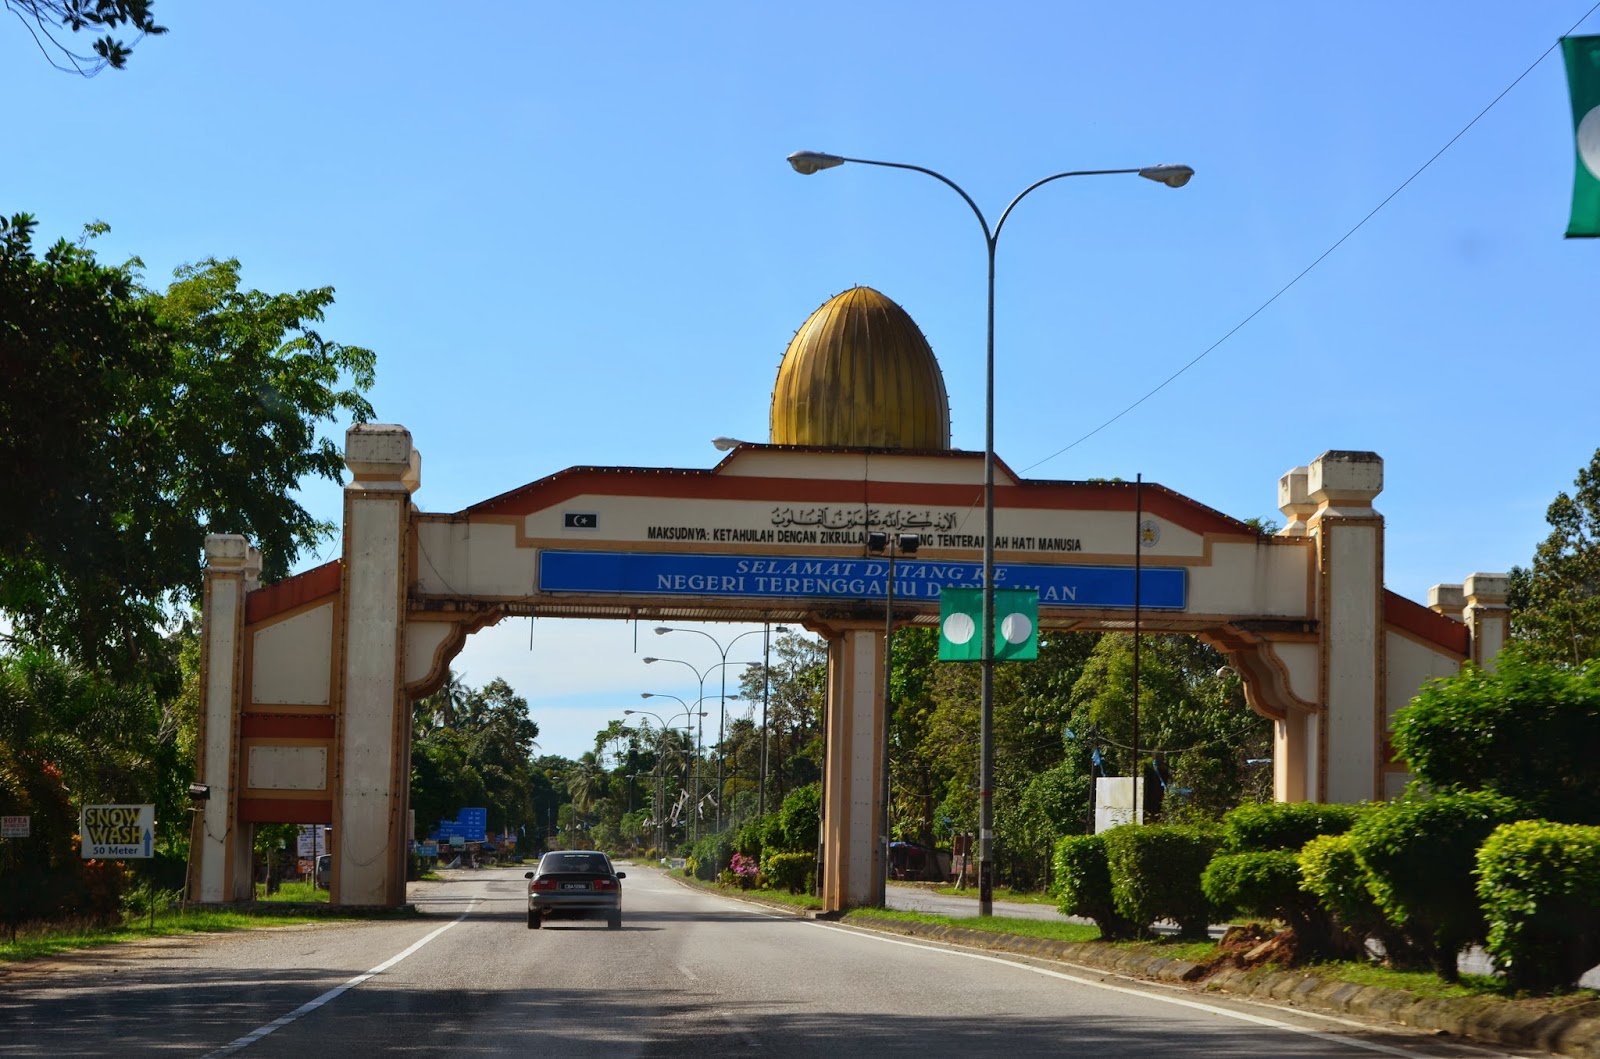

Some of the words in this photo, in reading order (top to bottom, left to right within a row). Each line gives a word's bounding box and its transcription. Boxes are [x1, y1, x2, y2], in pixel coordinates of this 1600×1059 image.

[647, 526, 710, 541] MAKSUDNYA:
[713, 528, 774, 543] KETAHUILAH
[777, 530, 817, 544] DENGAN
[820, 531, 872, 545] ZIKRULLA
[938, 534, 1009, 550] TENTERAAH
[1011, 536, 1036, 550] HATI
[1038, 537, 1082, 552] MANUSIA
[735, 560, 856, 576] SELAMAT
[864, 563, 964, 580] DATANG
[657, 574, 745, 592] NEGERI
[754, 576, 917, 597] TERENGGANU
[85, 808, 141, 827] SNOW
[87, 825, 143, 845] WASH
[92, 845, 105, 855] 50
[108, 845, 138, 855] Meter
